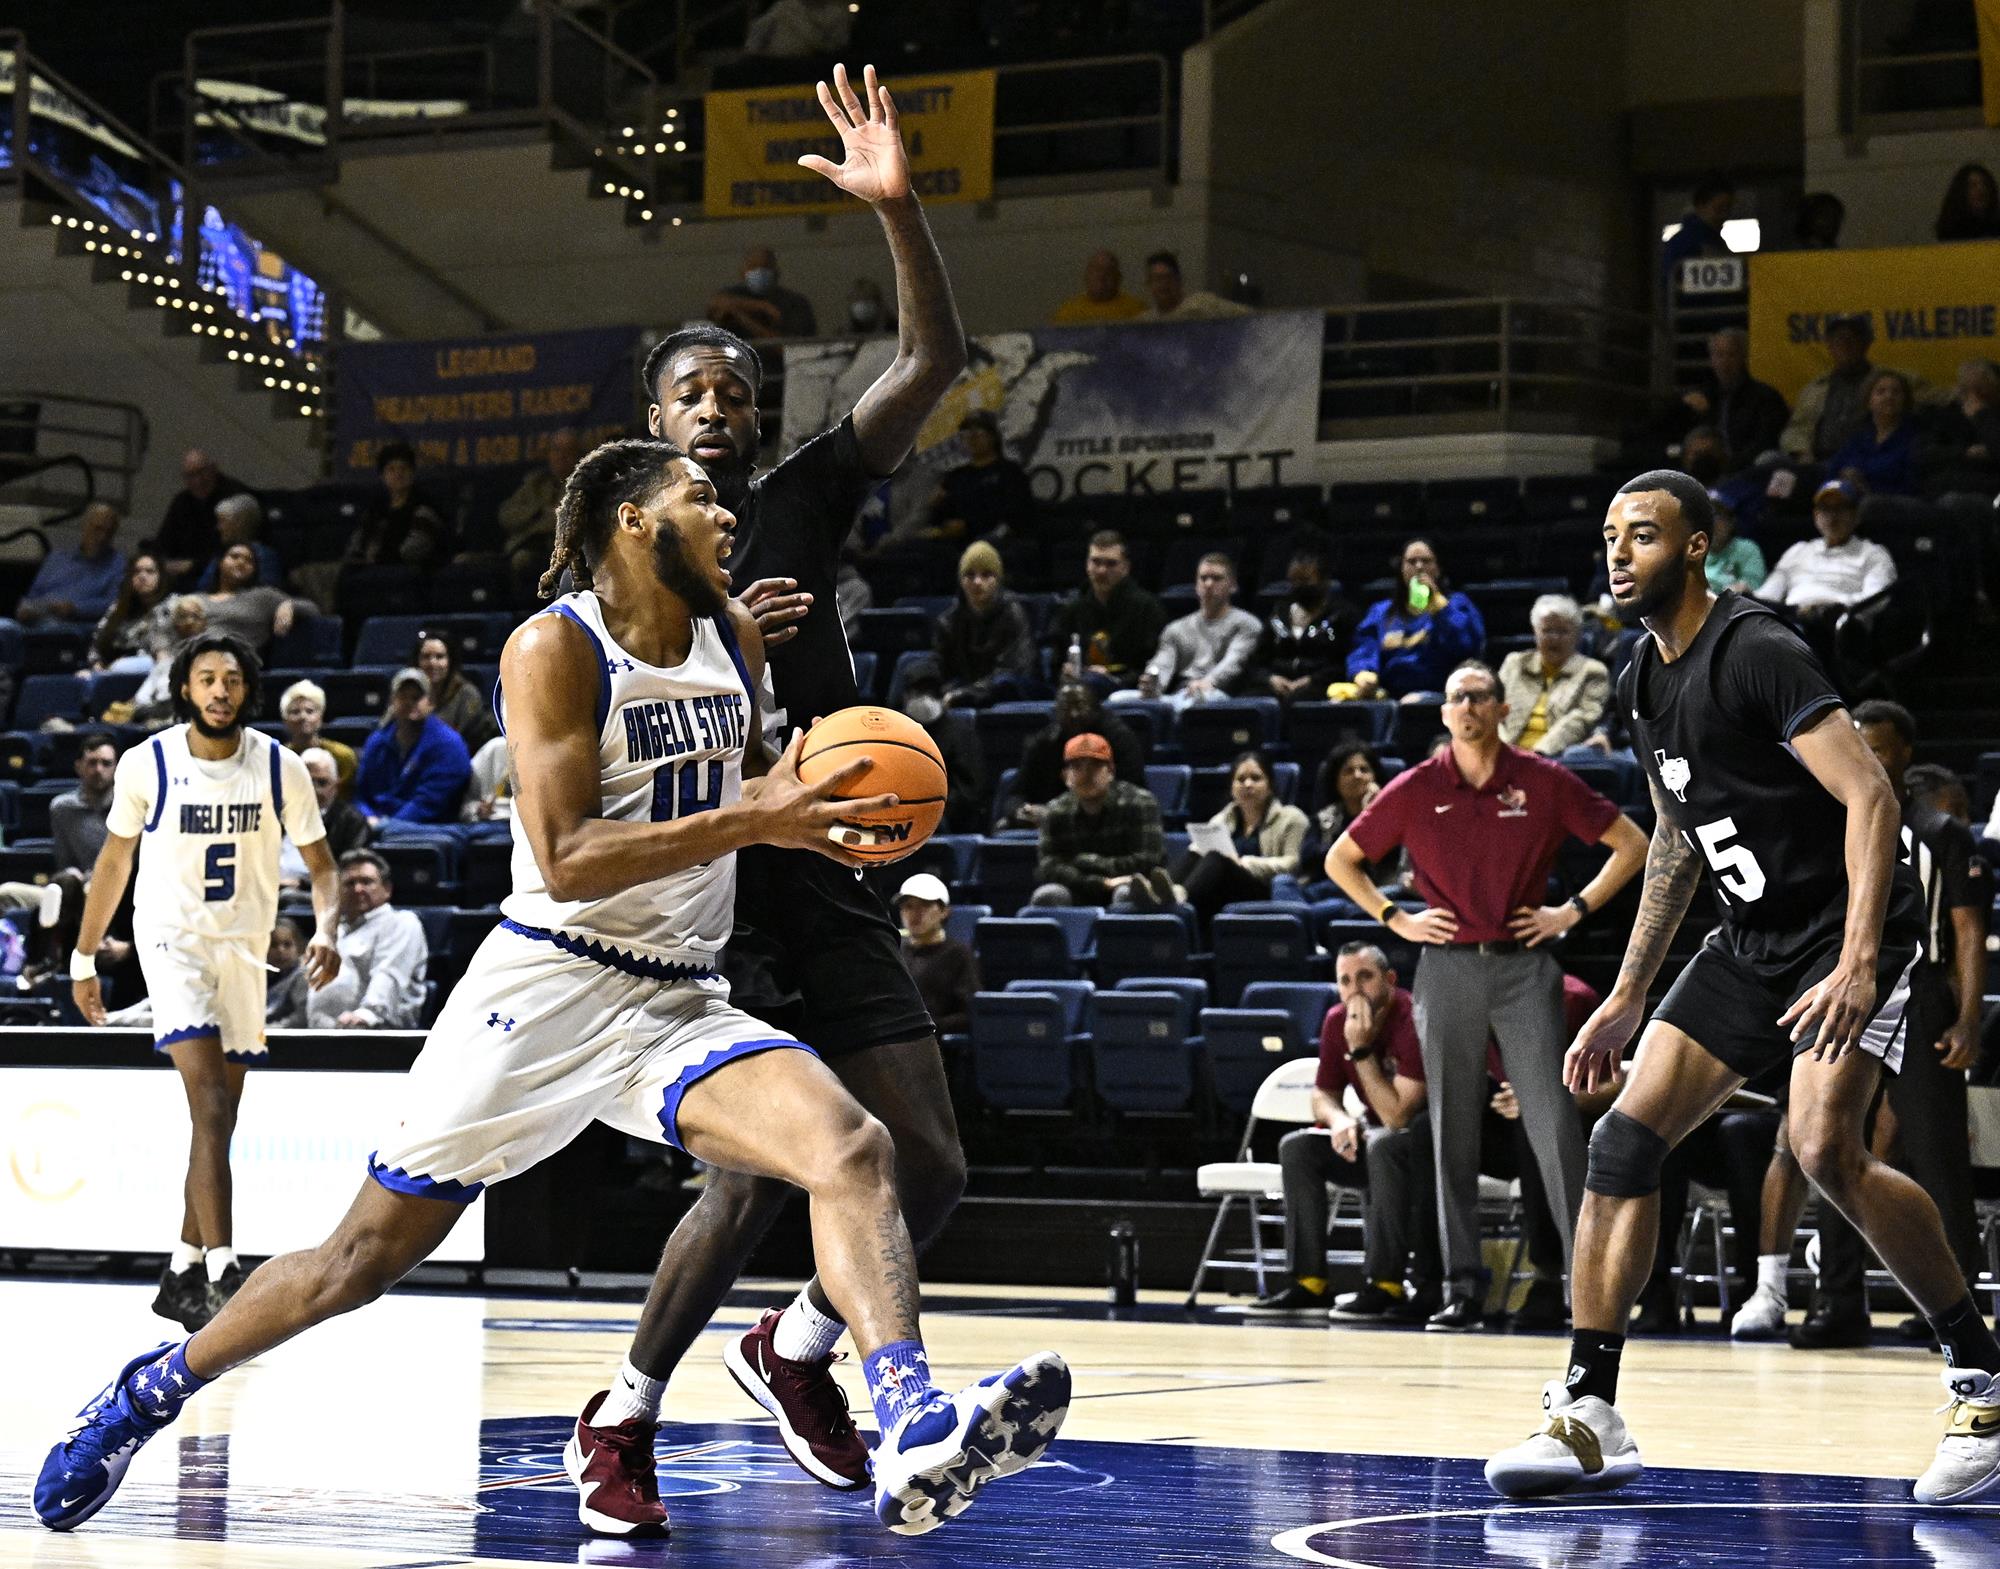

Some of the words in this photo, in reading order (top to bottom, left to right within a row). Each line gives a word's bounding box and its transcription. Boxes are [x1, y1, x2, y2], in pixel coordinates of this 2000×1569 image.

[1688, 261, 1735, 287] 103
[1884, 304, 1996, 341] VALERIE
[435, 344, 537, 379] LEGRAND
[519, 383, 593, 417] RANCH
[1054, 437, 1112, 456] TITLE
[1117, 431, 1216, 453] SPONSOR
[1028, 449, 1294, 502] OCKETT
[623, 698, 697, 763] ANGELO
[693, 693, 745, 750] STATE
[226, 803, 262, 834] STATE
[204, 842, 237, 902] 5
[1680, 816, 1767, 906] 5
